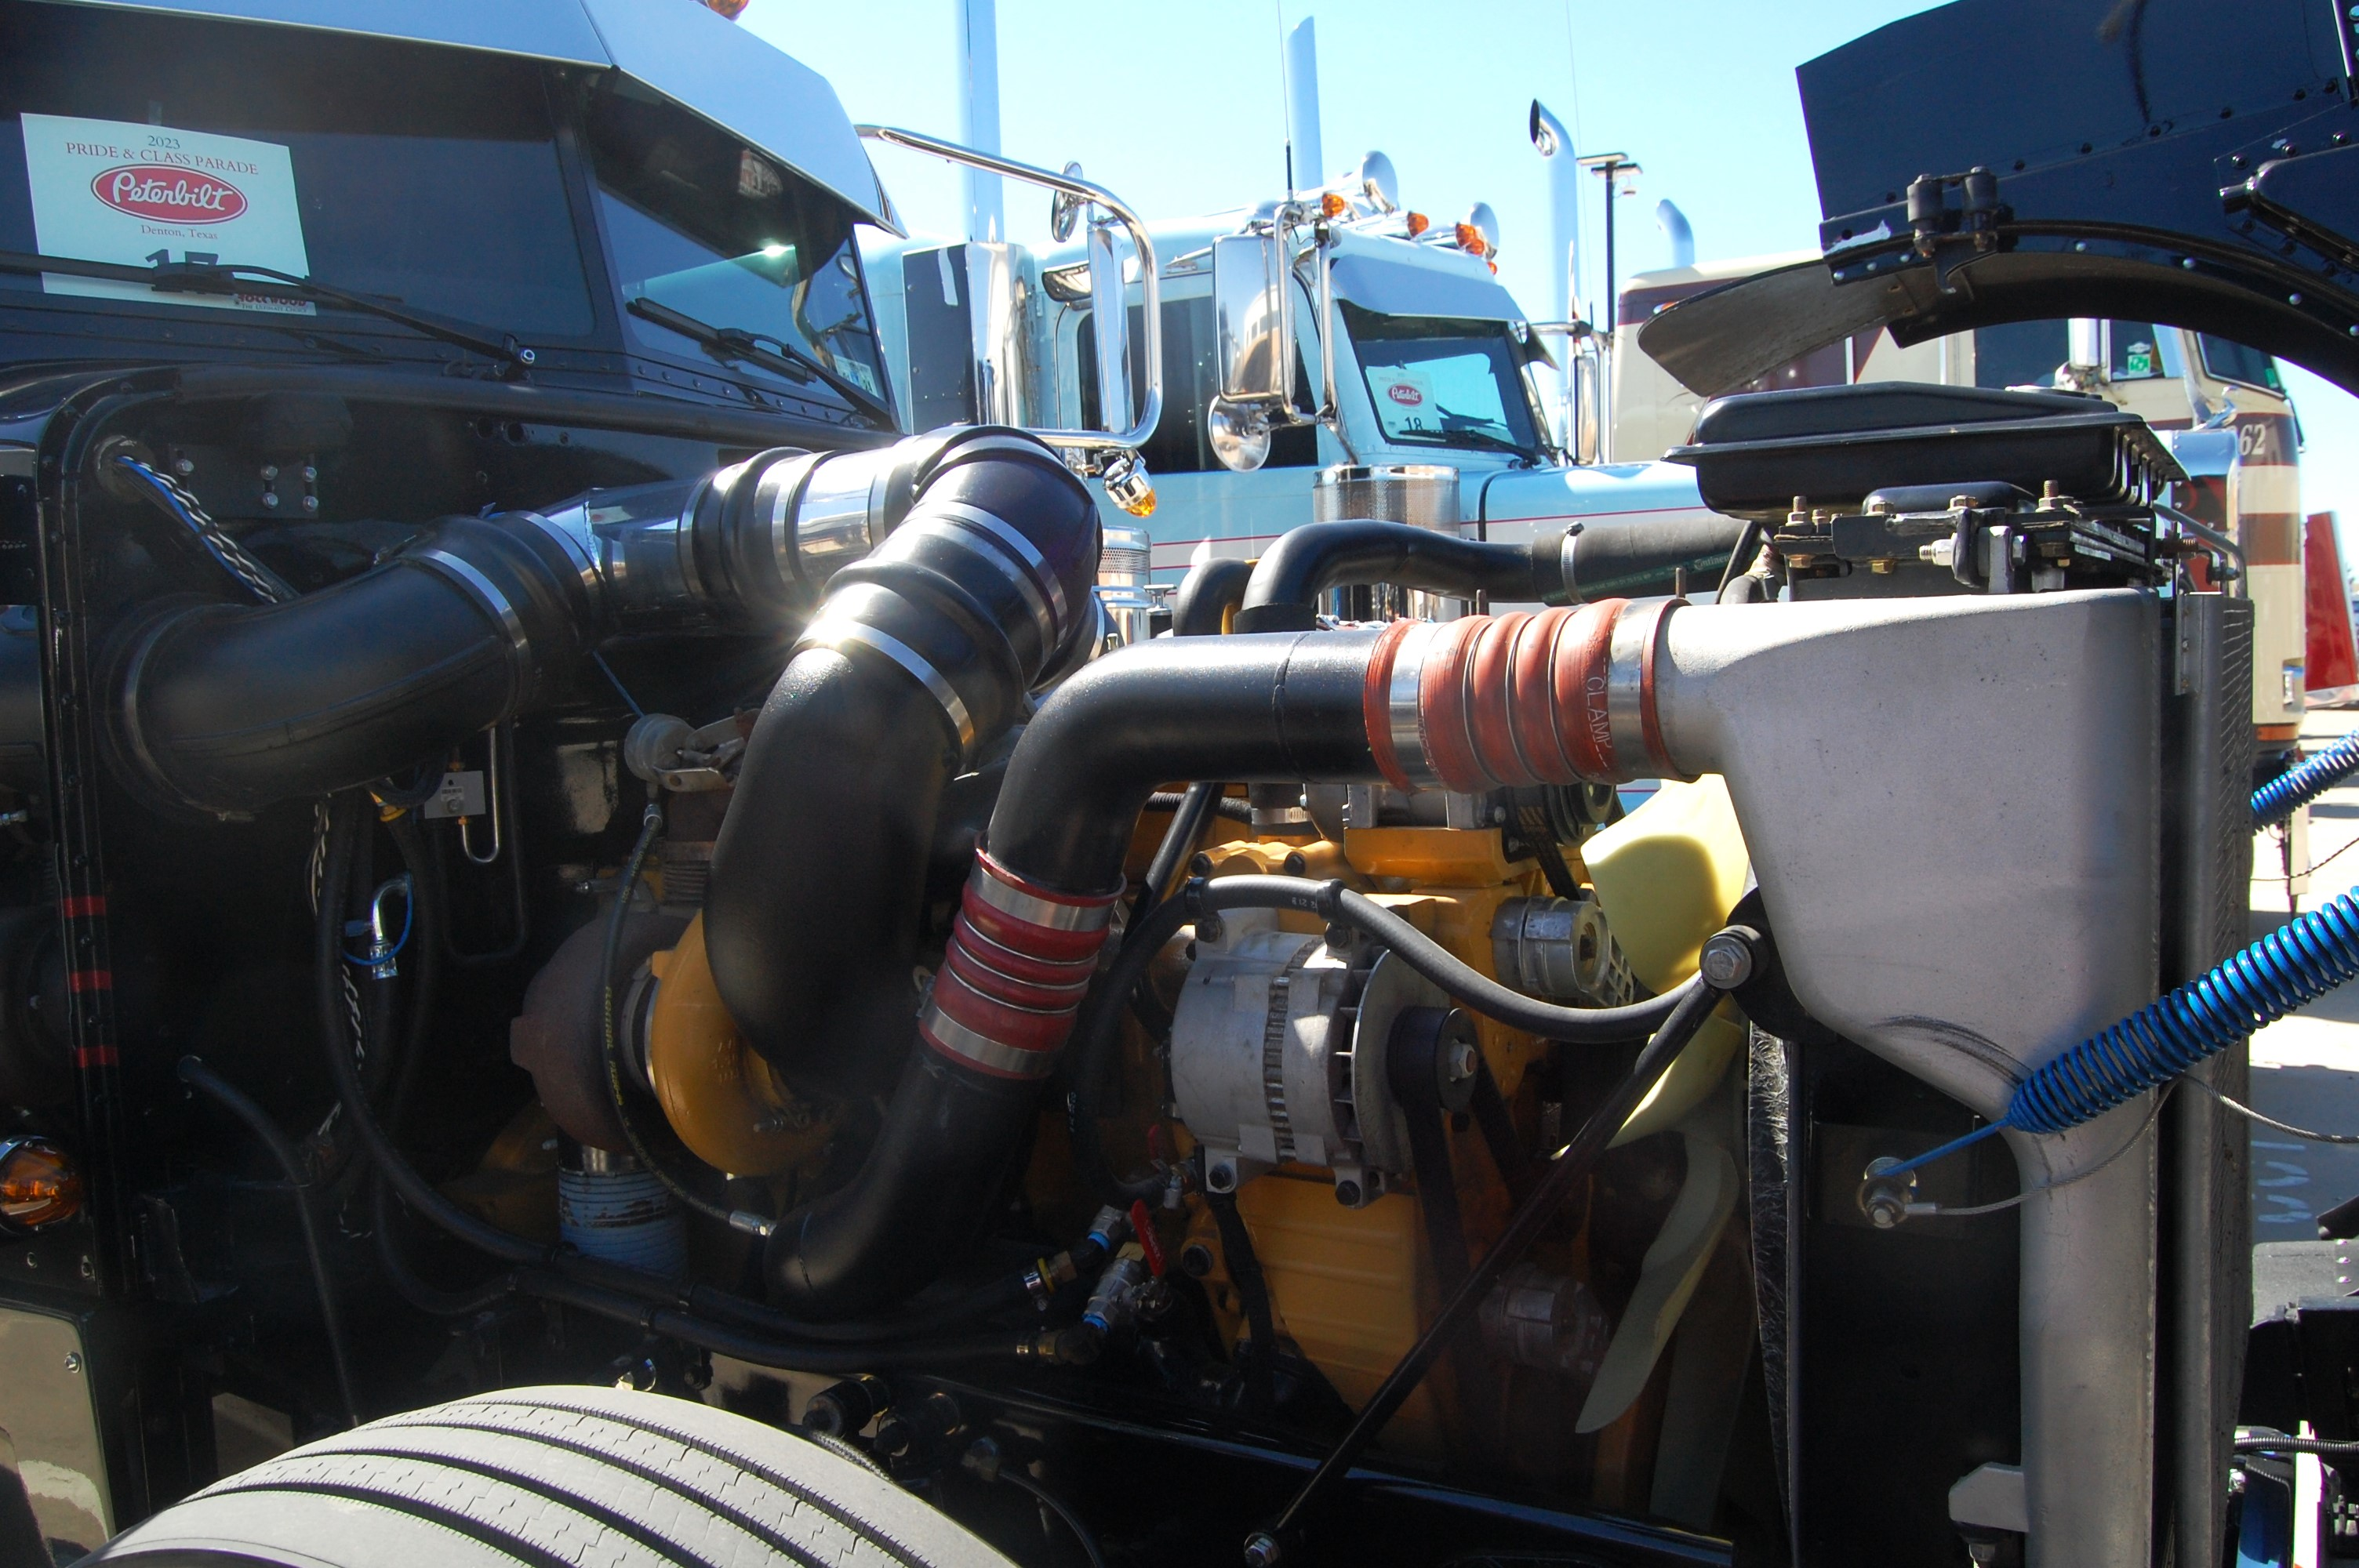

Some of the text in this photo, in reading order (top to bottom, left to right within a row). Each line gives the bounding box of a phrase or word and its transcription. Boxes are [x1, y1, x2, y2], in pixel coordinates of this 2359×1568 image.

[66, 142, 259, 176] PRIDE & CLASS PARADE
[147, 135, 181, 150] 2023
[113, 171, 234, 212] Peterbilt
[141, 224, 218, 240] Denton, Texas
[2226, 423, 2266, 456] 62
